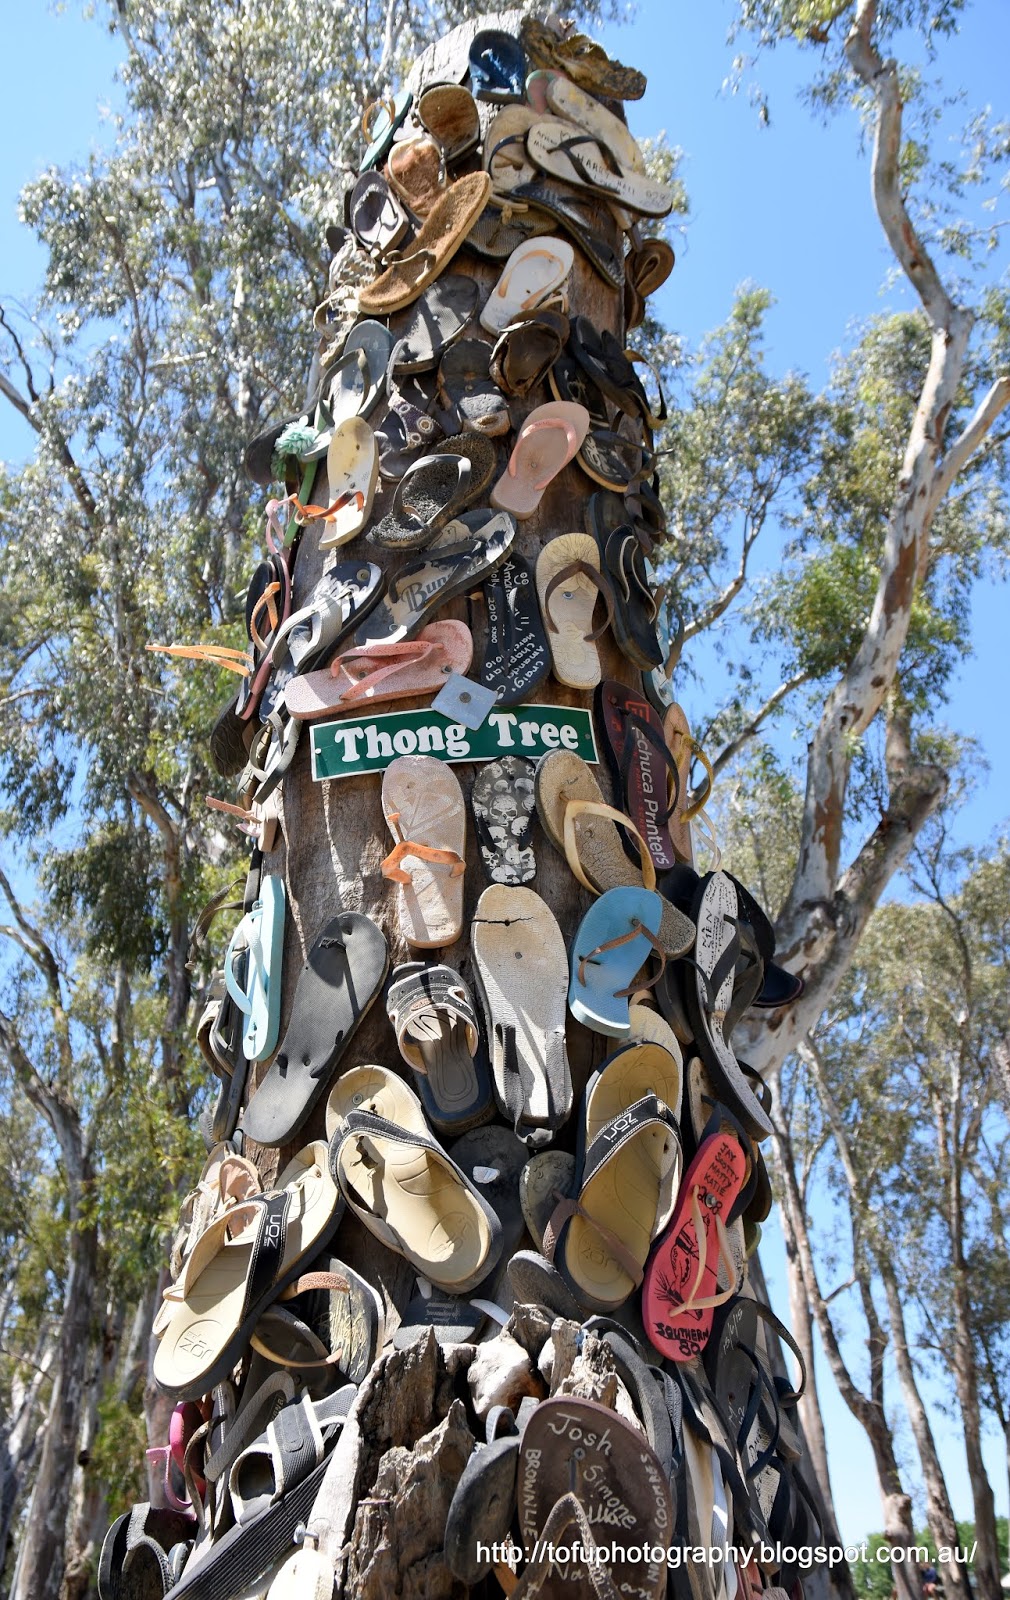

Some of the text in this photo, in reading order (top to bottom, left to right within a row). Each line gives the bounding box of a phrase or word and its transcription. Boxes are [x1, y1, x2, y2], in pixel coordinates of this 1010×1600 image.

[485, 643, 536, 682] Chapan
[335, 713, 579, 762] Thong Tree
[653, 1322, 709, 1342] SOUTHERN
[679, 1340, 701, 1356] 80
[547, 1412, 613, 1456] Josh
[583, 1465, 637, 1530] Simone
